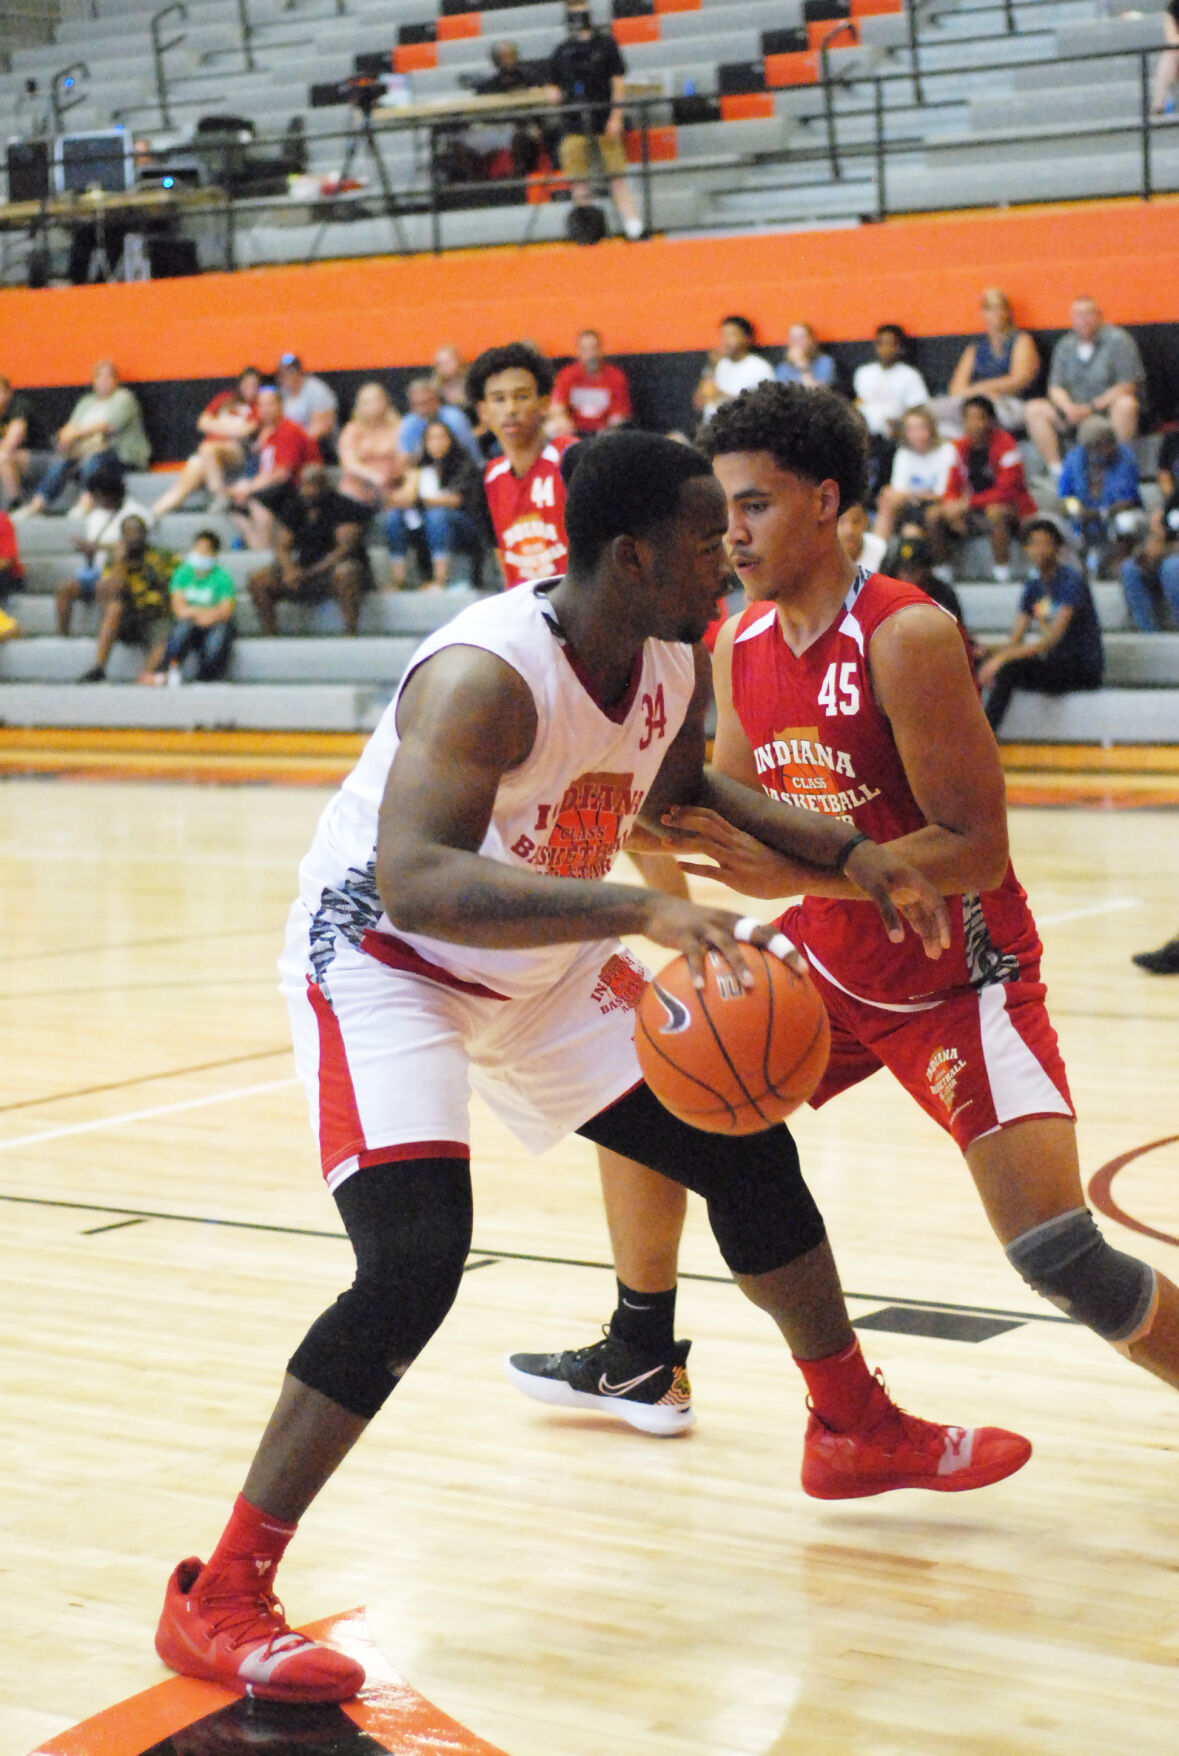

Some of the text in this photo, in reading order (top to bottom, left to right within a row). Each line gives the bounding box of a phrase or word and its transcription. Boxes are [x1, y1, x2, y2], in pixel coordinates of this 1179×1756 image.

[817, 662, 860, 717] 45
[639, 683, 667, 750] 34
[754, 739, 856, 778] INDIANA
[761, 783, 881, 813] ASKETBALL
[792, 776, 827, 790] CLASS
